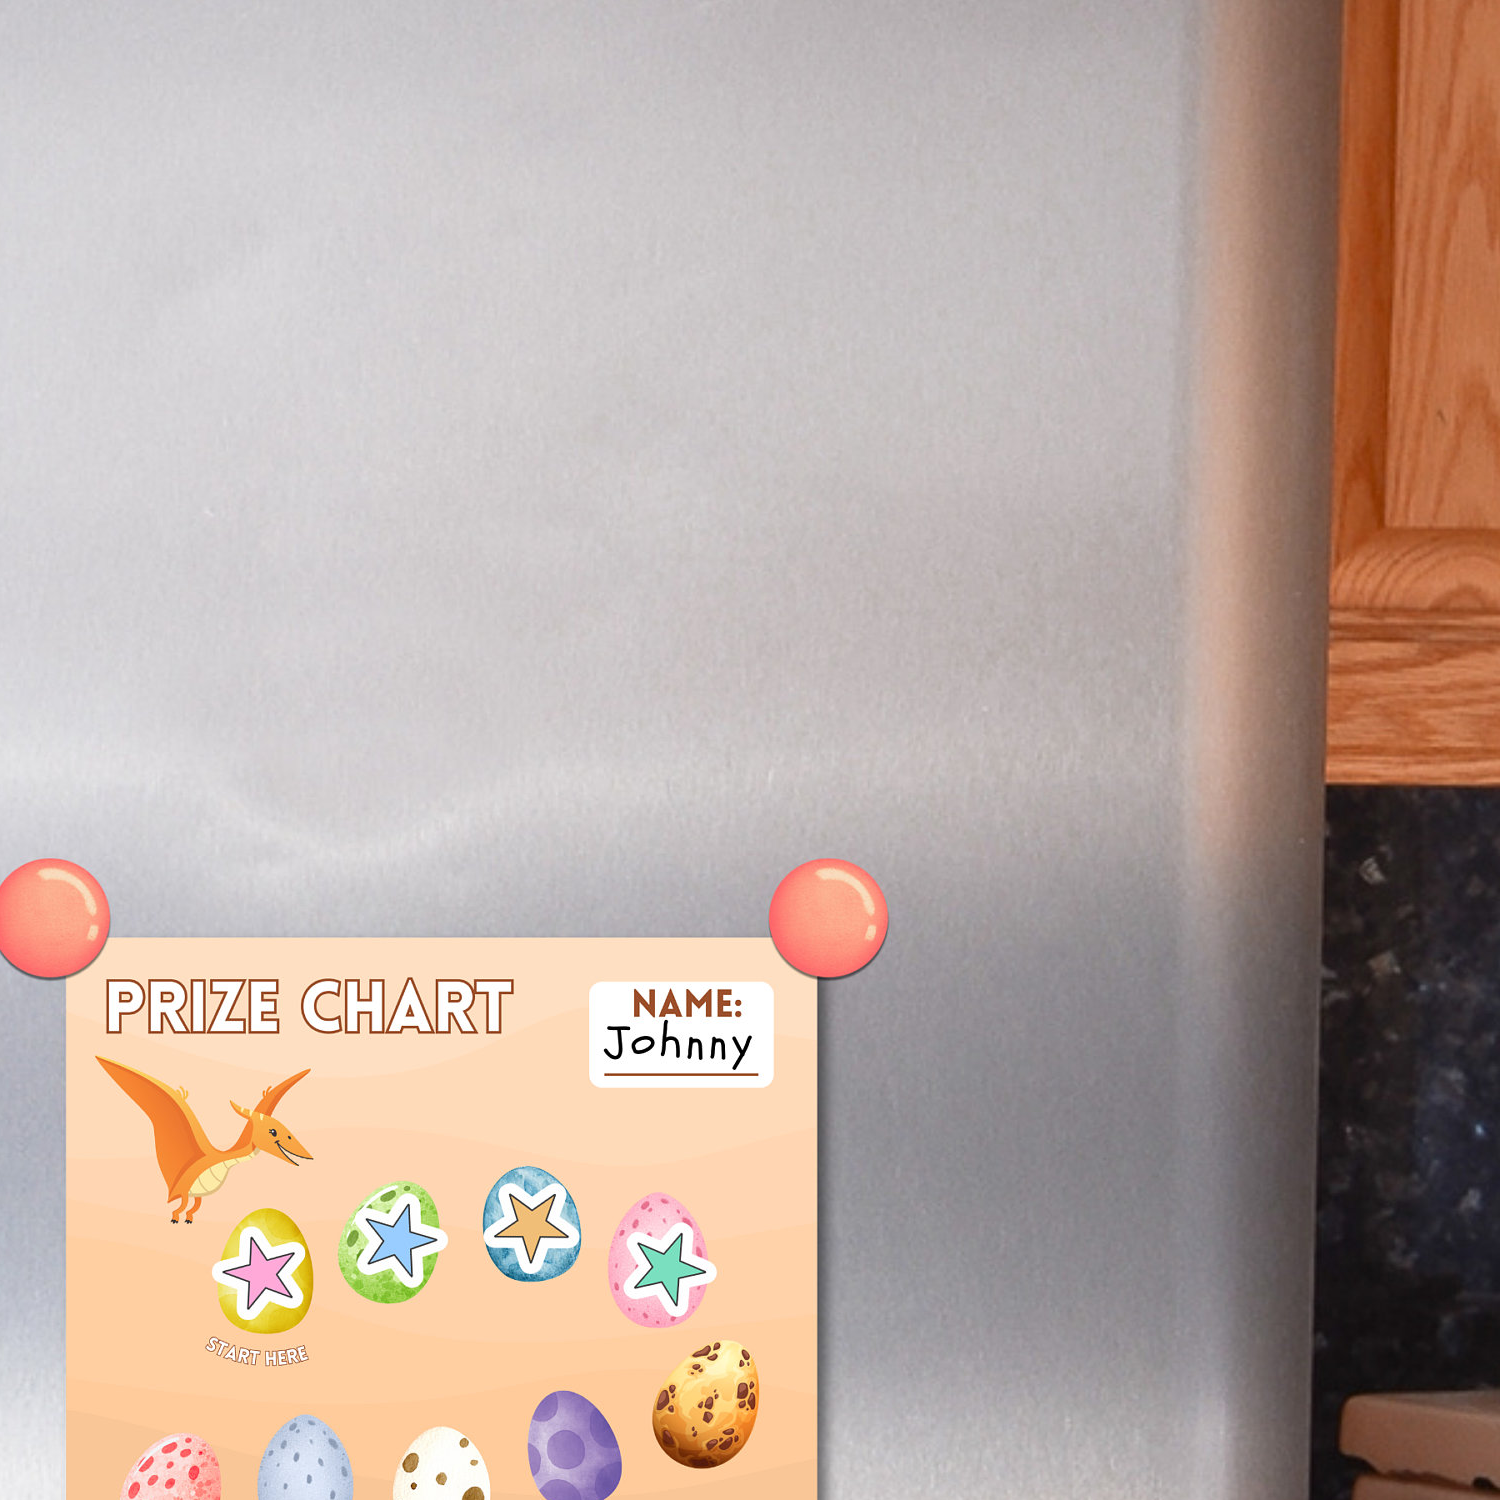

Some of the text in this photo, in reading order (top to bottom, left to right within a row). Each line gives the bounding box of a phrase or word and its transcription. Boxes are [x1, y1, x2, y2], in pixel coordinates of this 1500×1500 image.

[106, 977, 515, 1034] PRIZE CHART
[632, 988, 743, 1018] NAME:
[603, 1019, 753, 1071] Johnny
[205, 1336, 309, 1367] START HERE
